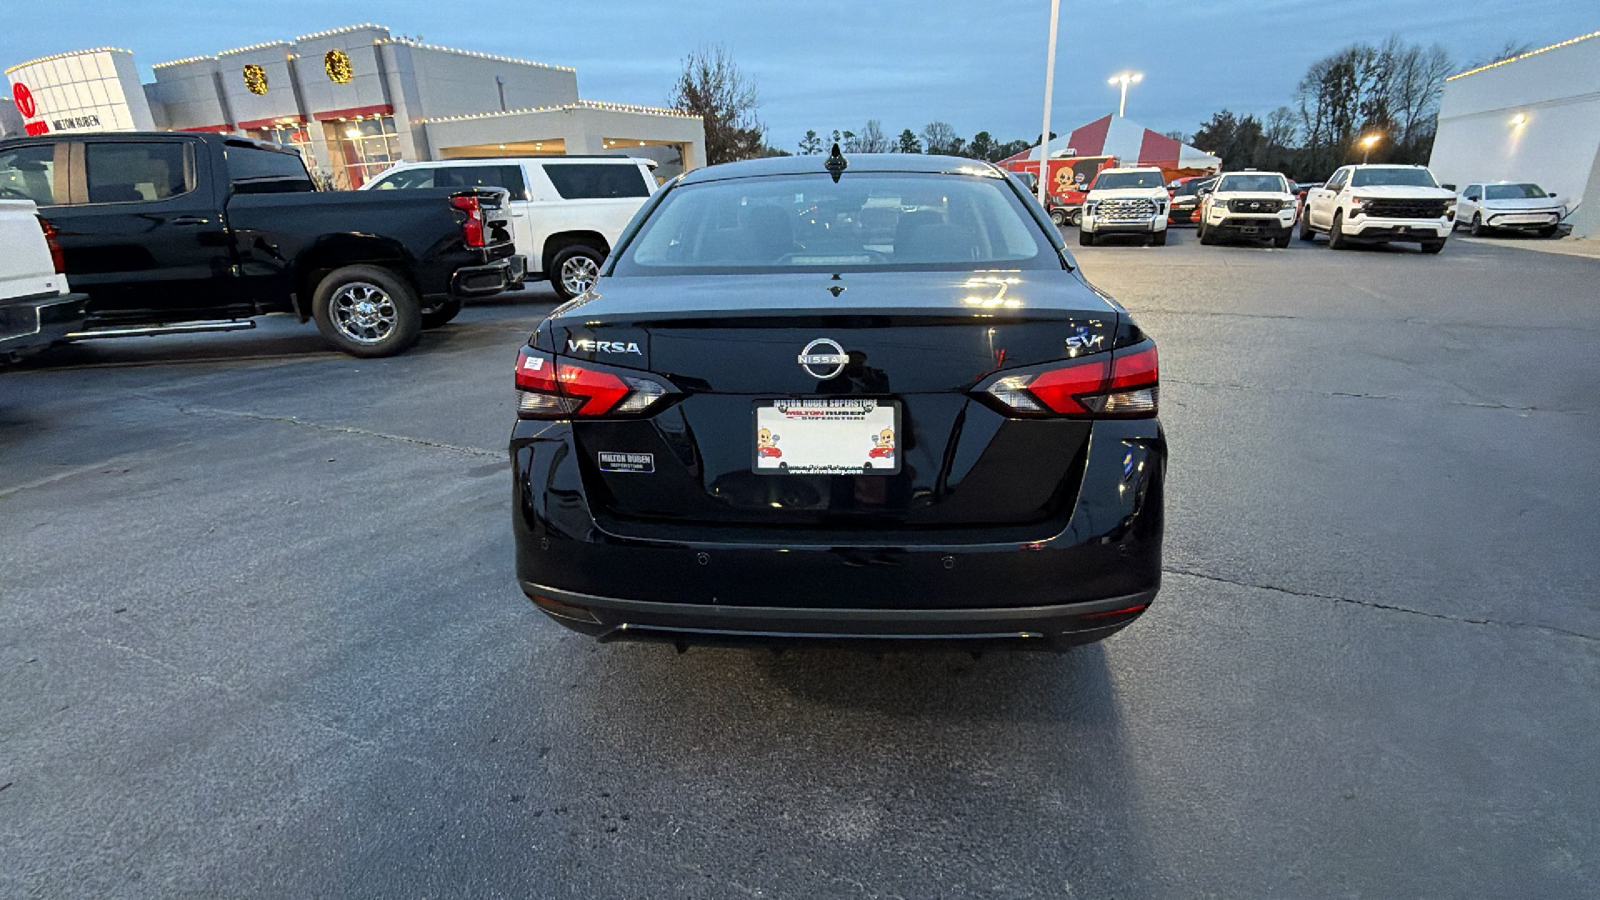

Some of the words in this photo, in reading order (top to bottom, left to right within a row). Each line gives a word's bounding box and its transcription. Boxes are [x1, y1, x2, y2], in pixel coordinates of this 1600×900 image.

[567, 339, 642, 355] VERSA
[774, 399, 801, 407] MILTON
[803, 399, 828, 407] RUBEN
[829, 399, 878, 407] SUPERSTORE
